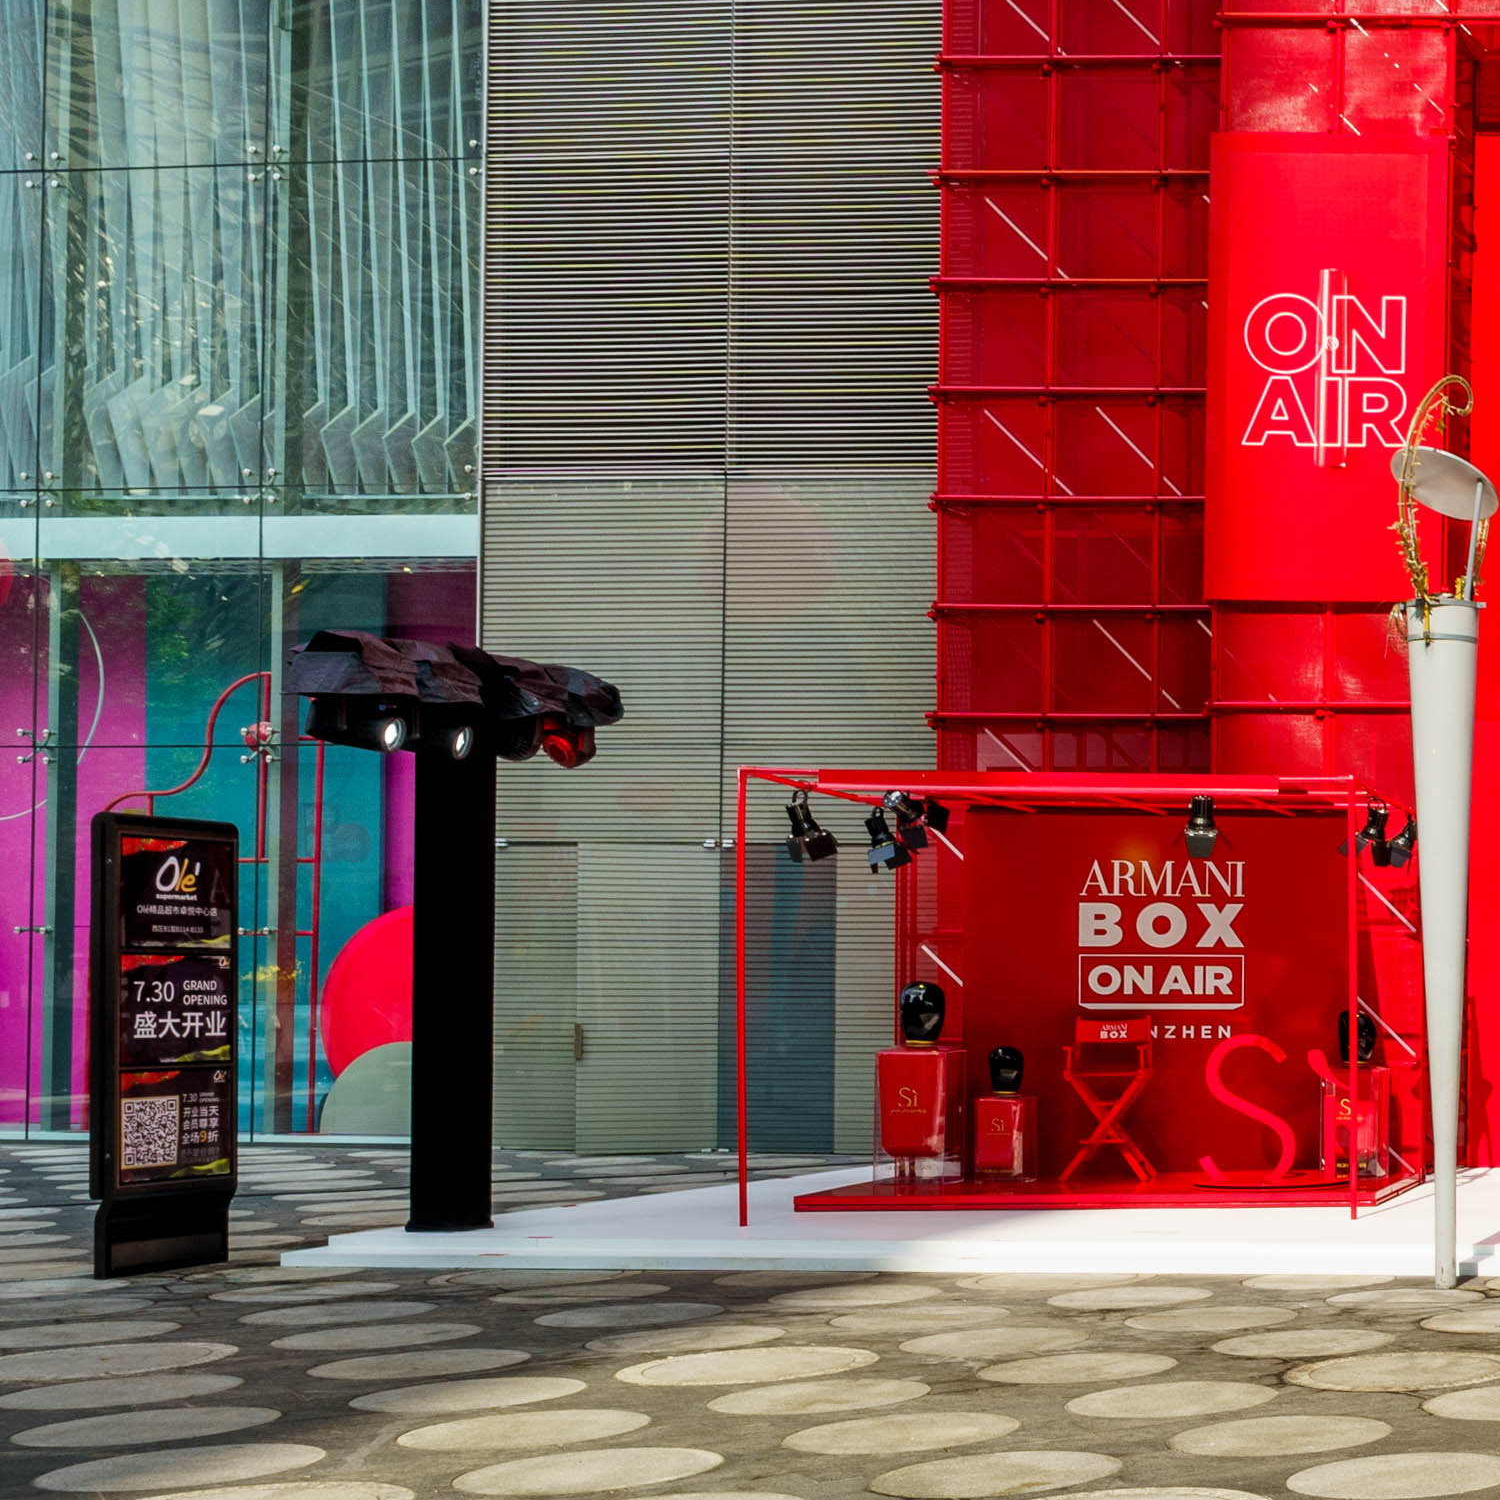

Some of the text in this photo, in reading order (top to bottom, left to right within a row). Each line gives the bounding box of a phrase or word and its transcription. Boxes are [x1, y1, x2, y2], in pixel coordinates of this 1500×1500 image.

[1243, 293, 1406, 374] ON
[1241, 376, 1408, 448] AIR
[1079, 860, 1246, 898] ARMANI
[155, 893, 198, 901] supermarket
[1078, 901, 1246, 949] BOX
[183, 980, 218, 991] GRAND
[1088, 964, 1233, 996] ON AIR
[133, 980, 175, 1003] 7.30
[183, 994, 228, 1006] OPENING
[133, 1010, 227, 1039] 盛大开业
[1101, 1023, 1128, 1031] ARMANI
[1151, 1025, 1232, 1039] NZHEN
[1100, 1030, 1128, 1039] BOX
[1339, 1098, 1352, 1116] S
[182, 1130, 219, 1146] 全场9折
